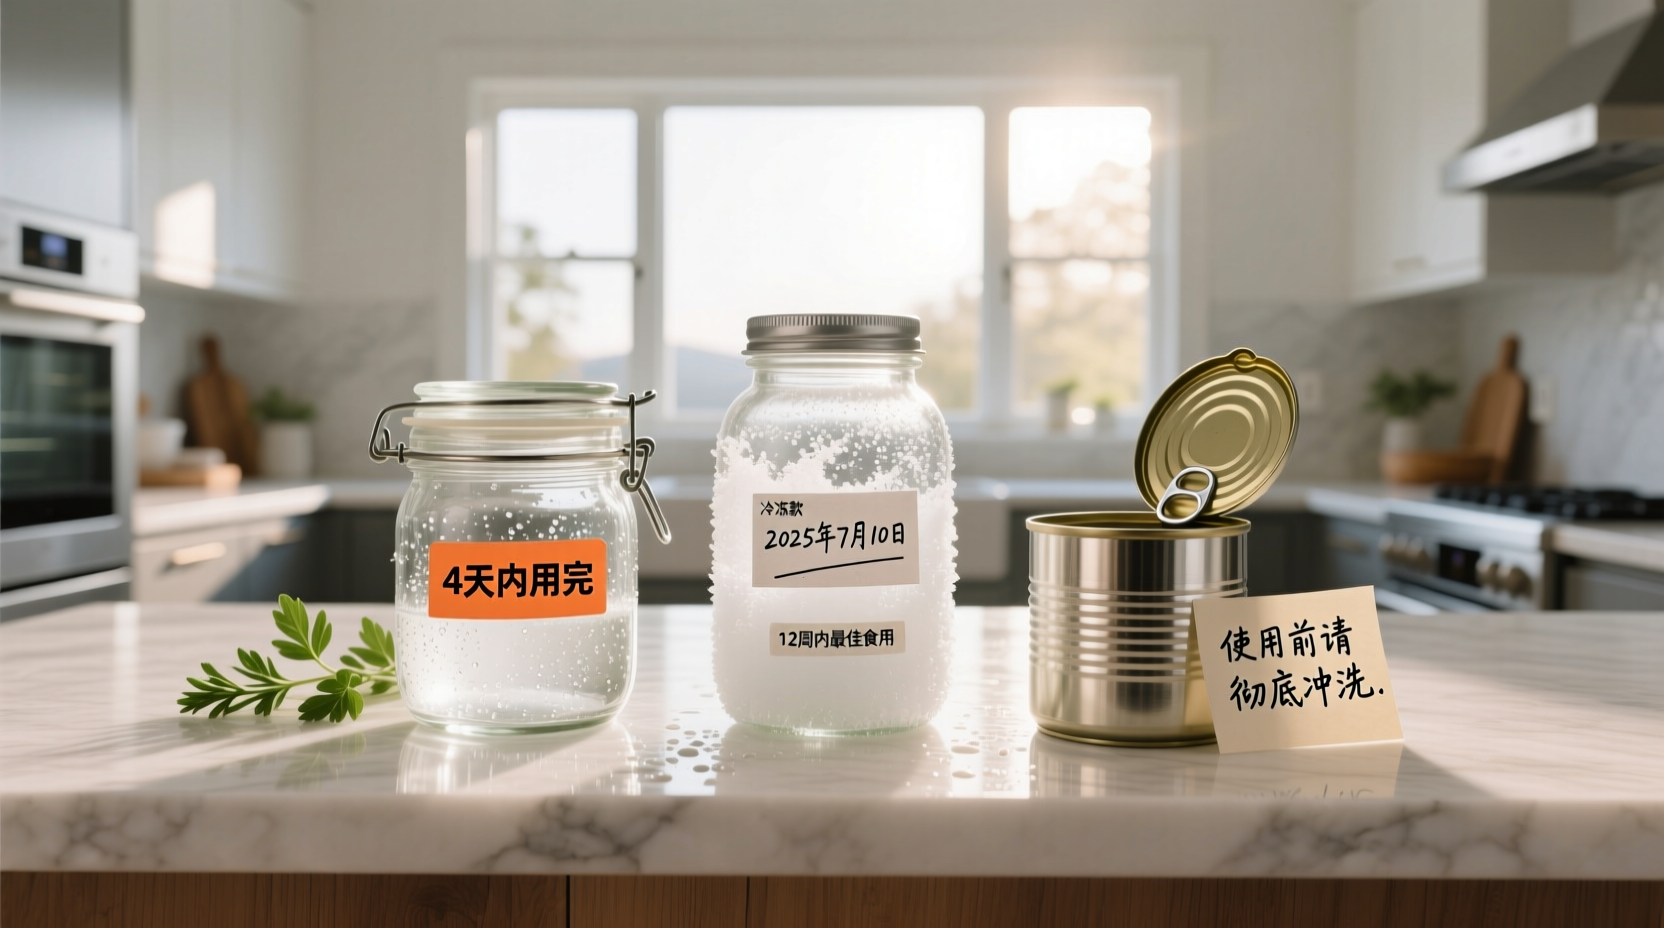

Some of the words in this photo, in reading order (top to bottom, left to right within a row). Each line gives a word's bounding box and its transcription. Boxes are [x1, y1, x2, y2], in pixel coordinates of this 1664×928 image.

[764, 520, 905, 554] 2025年7月10日
[442, 560, 594, 599] 4天内用完
[1220, 615, 1353, 663] 使用前请
